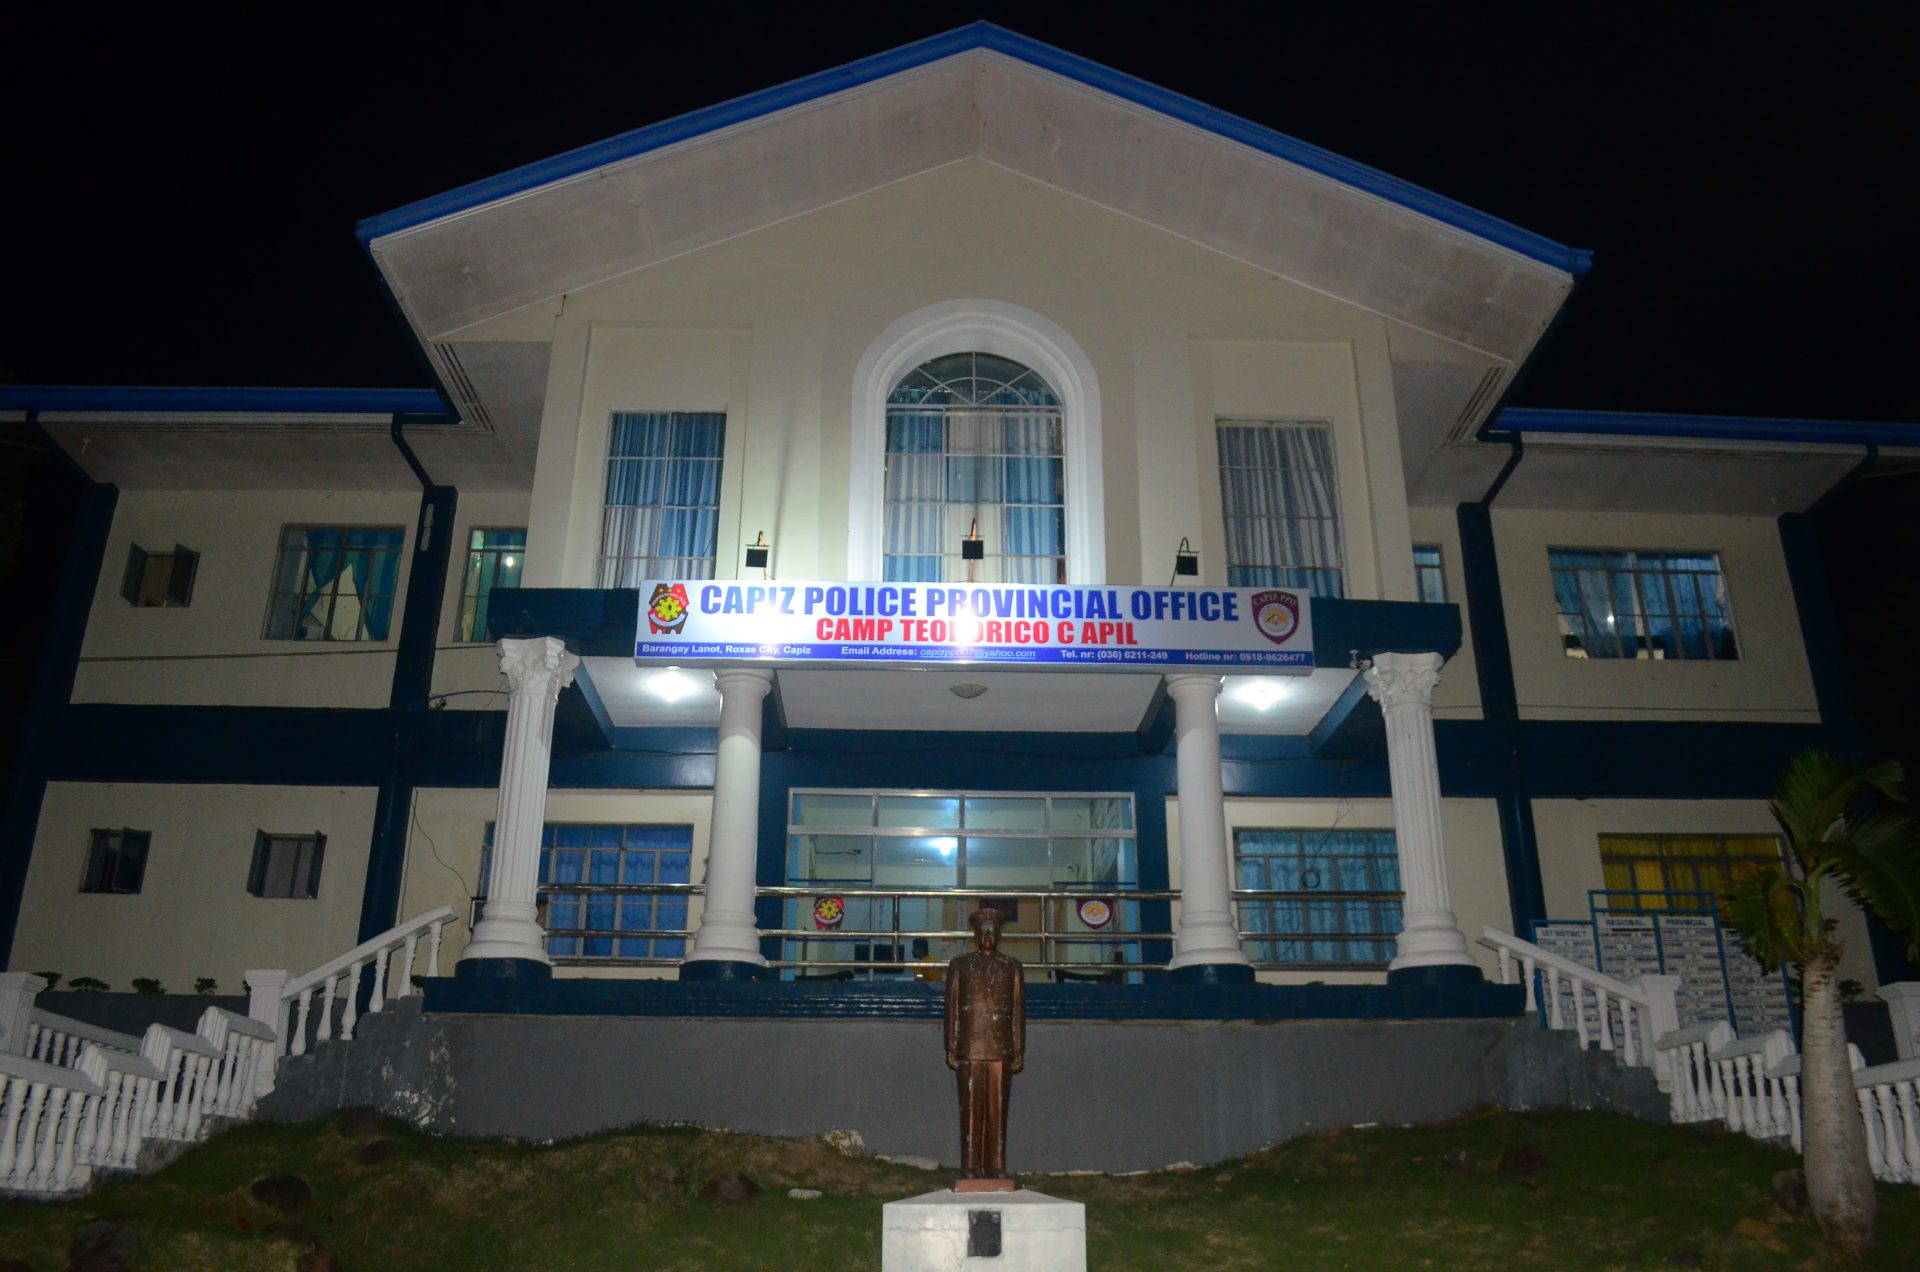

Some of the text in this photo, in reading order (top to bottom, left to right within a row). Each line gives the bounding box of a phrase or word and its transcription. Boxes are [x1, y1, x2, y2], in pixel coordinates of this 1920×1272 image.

[701, 585, 795, 615] CAPIZ
[804, 586, 917, 616] POLICE
[926, 588, 1123, 619] PROVINCIAL
[1131, 590, 1239, 621] OFFICE
[816, 617, 893, 641] CAMP
[1057, 621, 1074, 644] C
[1081, 621, 1138, 645] APIL
[642, 644, 689, 654] Barangay
[692, 645, 722, 654] Lanot,
[726, 645, 756, 653] Roxas
[783, 646, 811, 655] Capiz
[841, 646, 869, 655] Email
[872, 647, 917, 655] Address:
[1061, 649, 1077, 658] Tel.
[1081, 650, 1094, 658] nr:
[1097, 650, 1122, 660] (036)
[1124, 651, 1168, 660] 6211-249
[1185, 652, 1220, 660] Hotline
